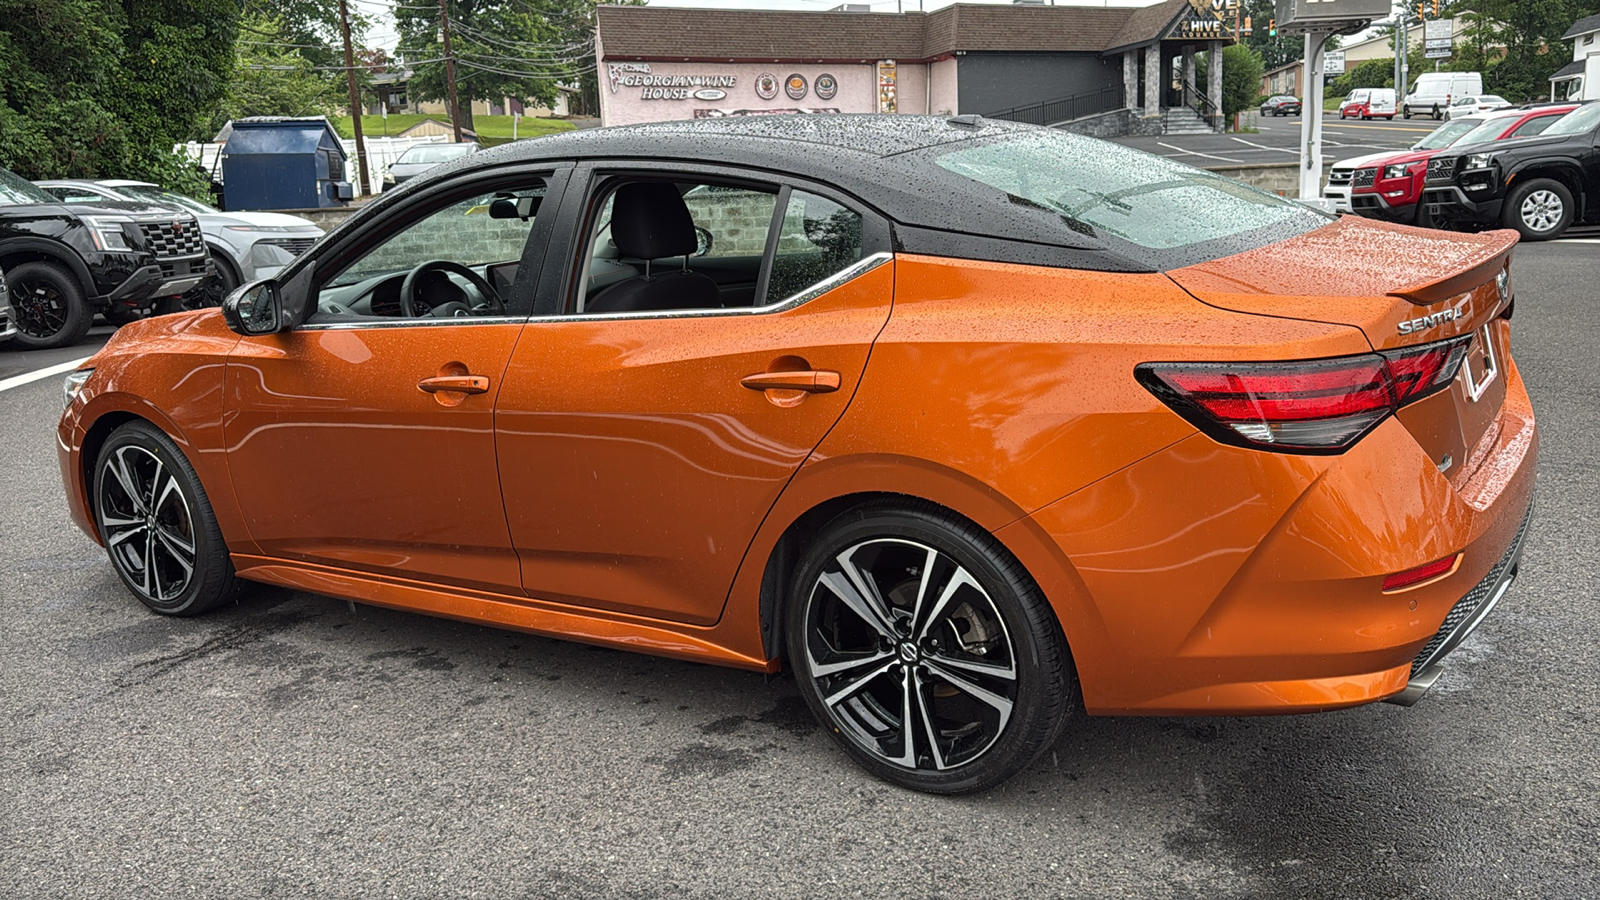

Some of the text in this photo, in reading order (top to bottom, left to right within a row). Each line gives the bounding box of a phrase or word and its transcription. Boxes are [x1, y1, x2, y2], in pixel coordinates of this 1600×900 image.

[1191, 20, 1221, 32] HIVE
[624, 75, 737, 87] GEORGIAN WINE
[641, 88, 688, 100] HOUSE
[1398, 308, 1462, 335] SENTRA
